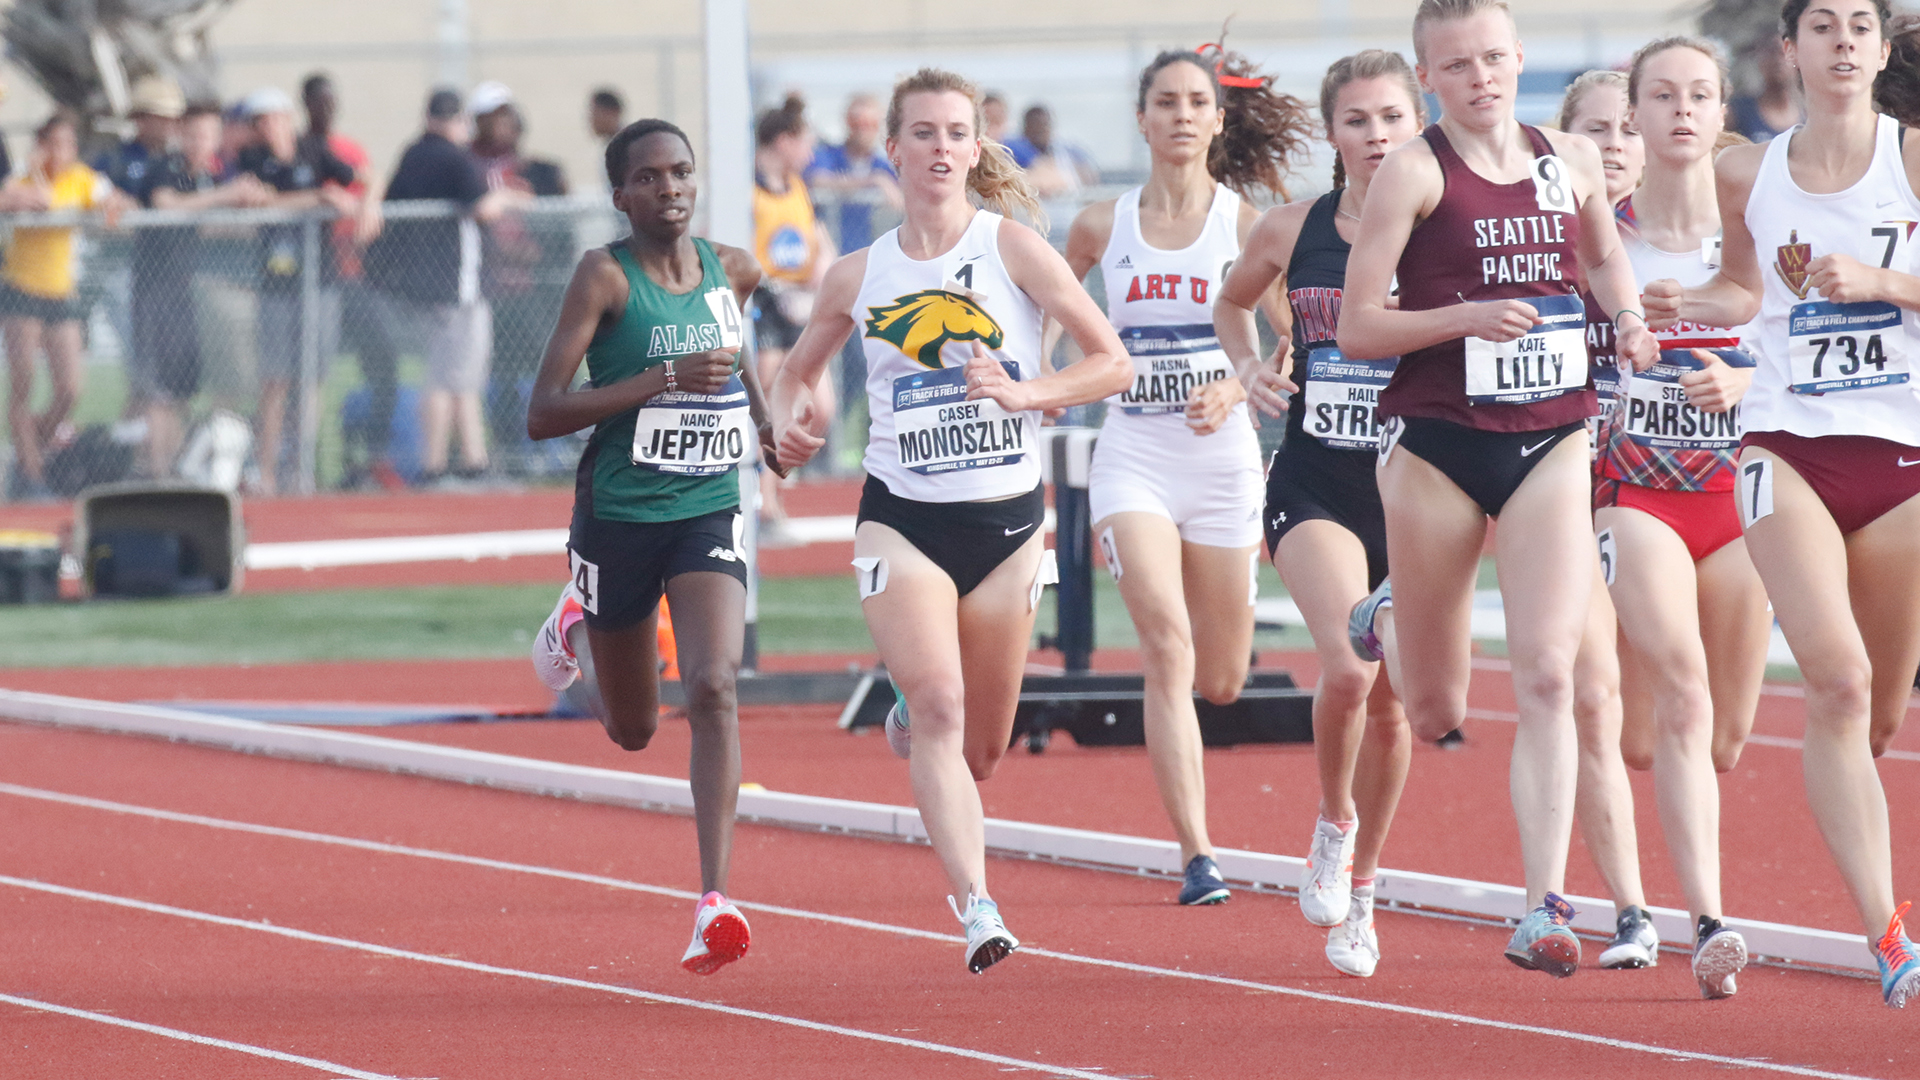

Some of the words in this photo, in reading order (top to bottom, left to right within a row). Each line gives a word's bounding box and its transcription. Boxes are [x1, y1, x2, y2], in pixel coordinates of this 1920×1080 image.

[1537, 158, 1565, 208] 8
[1474, 215, 1565, 248] SEATTLE
[1871, 227, 1898, 269] 7
[954, 263, 973, 290] 1
[1482, 253, 1563, 285] PACIFIC
[1126, 274, 1182, 303] ART
[1190, 277, 1208, 304] U
[721, 294, 741, 343] 4
[1517, 337, 1546, 353] KATE
[1808, 334, 1887, 378] 734
[1151, 358, 1191, 372] HASNA
[1327, 366, 1348, 375] TRACK
[1354, 368, 1373, 377] FIELD
[1496, 353, 1564, 390] LILLY
[912, 389, 934, 401] TRACK
[940, 386, 958, 397] FIELD
[1662, 386, 1688, 402] STE
[680, 413, 723, 428] NANCY
[938, 404, 980, 422] CASEY
[1628, 397, 1741, 438] PARSON
[641, 427, 744, 461] JEPTOO
[898, 417, 1023, 464] MONOSZLAY
[1744, 461, 1764, 520] 7
[575, 562, 593, 608] 4
